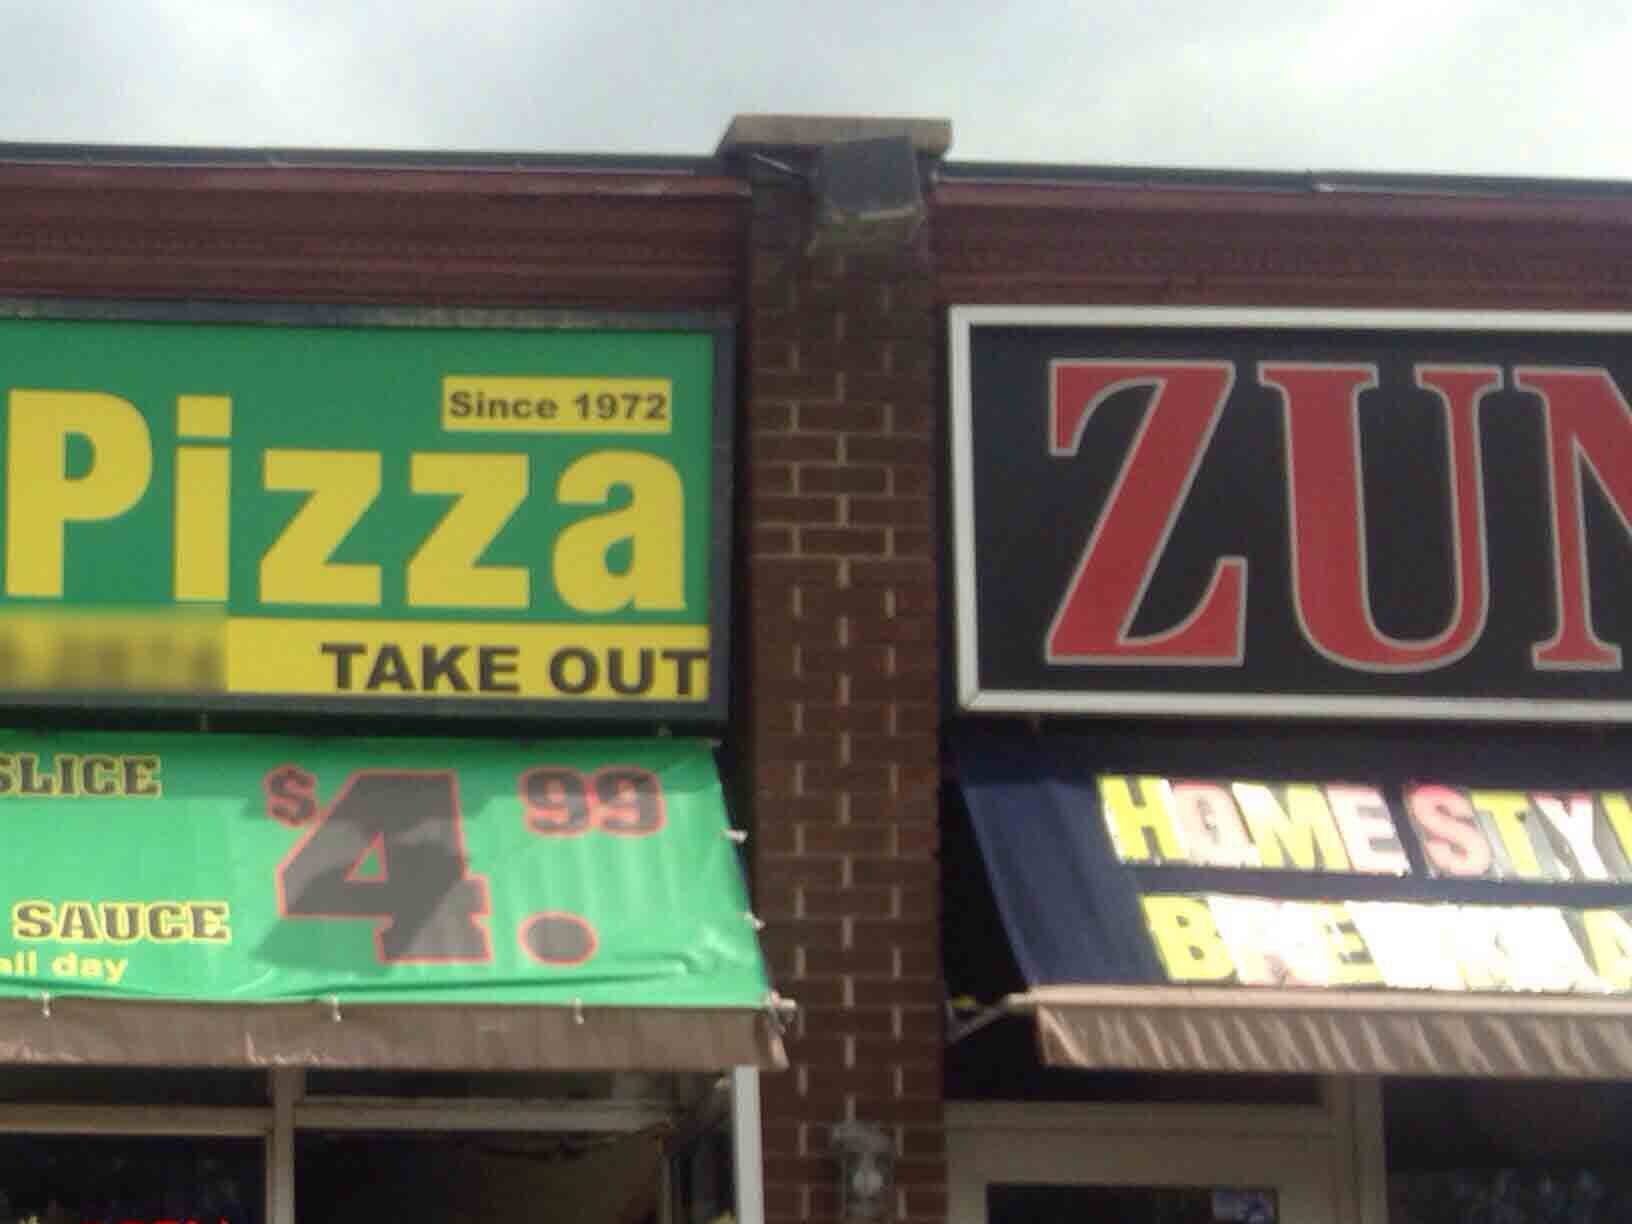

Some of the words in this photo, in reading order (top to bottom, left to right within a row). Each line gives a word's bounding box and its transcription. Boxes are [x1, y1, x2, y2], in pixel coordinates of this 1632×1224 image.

[448, 391, 559, 420] Since
[574, 391, 667, 421] 1972
[5, 388, 686, 613] Pizza
[321, 642, 521, 694] TAKE
[549, 647, 709, 697] OUT
[1096, 774, 1410, 877] HOME
[13, 902, 231, 944] SAUCE
[52, 951, 128, 983] day
